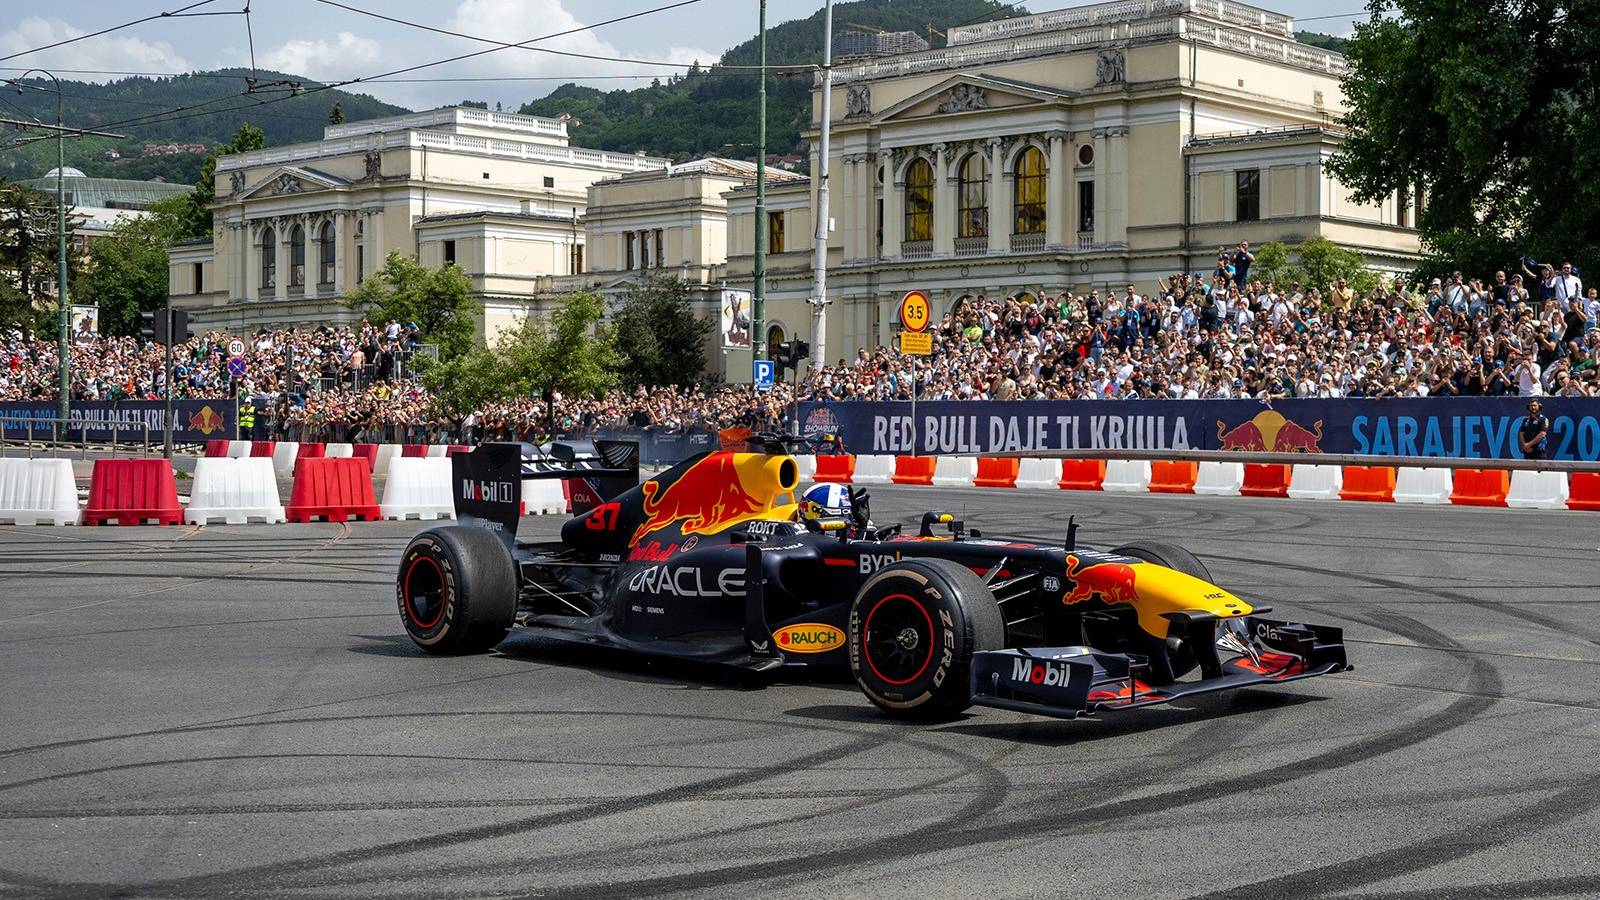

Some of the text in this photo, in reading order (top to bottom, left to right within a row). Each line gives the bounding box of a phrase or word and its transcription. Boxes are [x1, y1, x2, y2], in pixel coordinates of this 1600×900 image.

[231, 343, 242, 353] 60
[758, 364, 770, 381] P
[84, 409, 106, 430] BULL
[873, 416, 917, 451] RED
[924, 416, 981, 452] BULL
[988, 416, 1049, 453] DAJE
[1057, 416, 1080, 450] TI
[463, 479, 512, 502] Mobil 1
[573, 493, 591, 504] COLA
[585, 502, 621, 531] 37
[746, 521, 779, 536] ROKT
[441, 559, 456, 621] ZERO
[628, 565, 747, 598] ORACLE
[1043, 578, 1060, 591] FIA
[791, 631, 837, 645] RAUCH
[926, 586, 955, 689] P ZERO
[1256, 623, 1282, 641] Cla
[1011, 656, 1071, 688] Mobil
